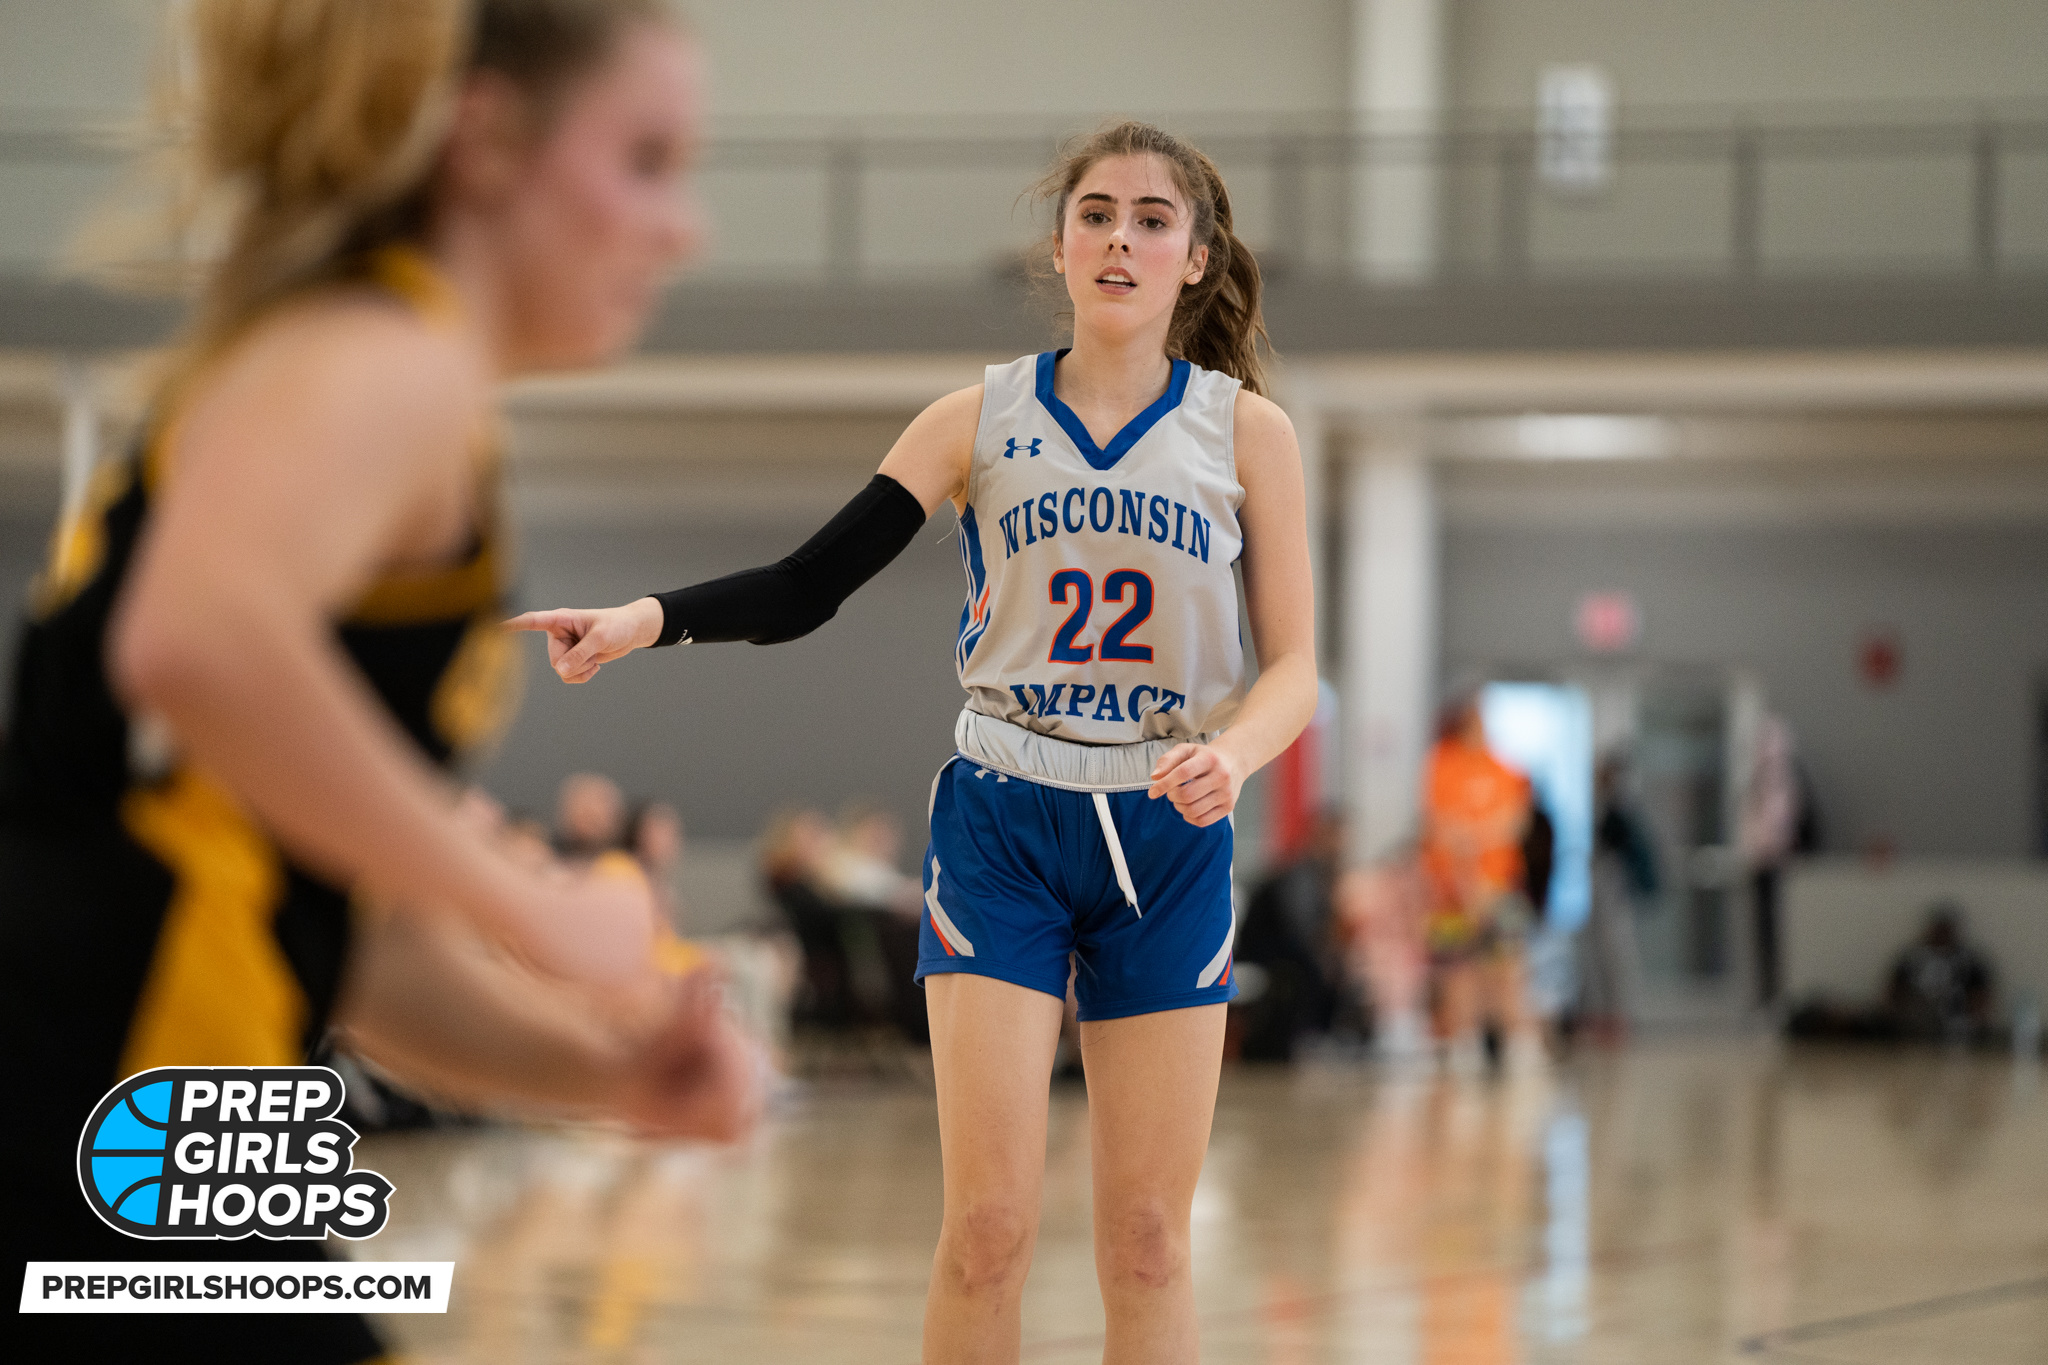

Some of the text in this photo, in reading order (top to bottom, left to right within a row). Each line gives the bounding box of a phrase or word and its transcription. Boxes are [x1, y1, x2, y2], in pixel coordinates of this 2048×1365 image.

[1000, 487, 1211, 564] WISCONSIN
[1048, 568, 1154, 664] 22
[1009, 683, 1186, 722] IMPACT
